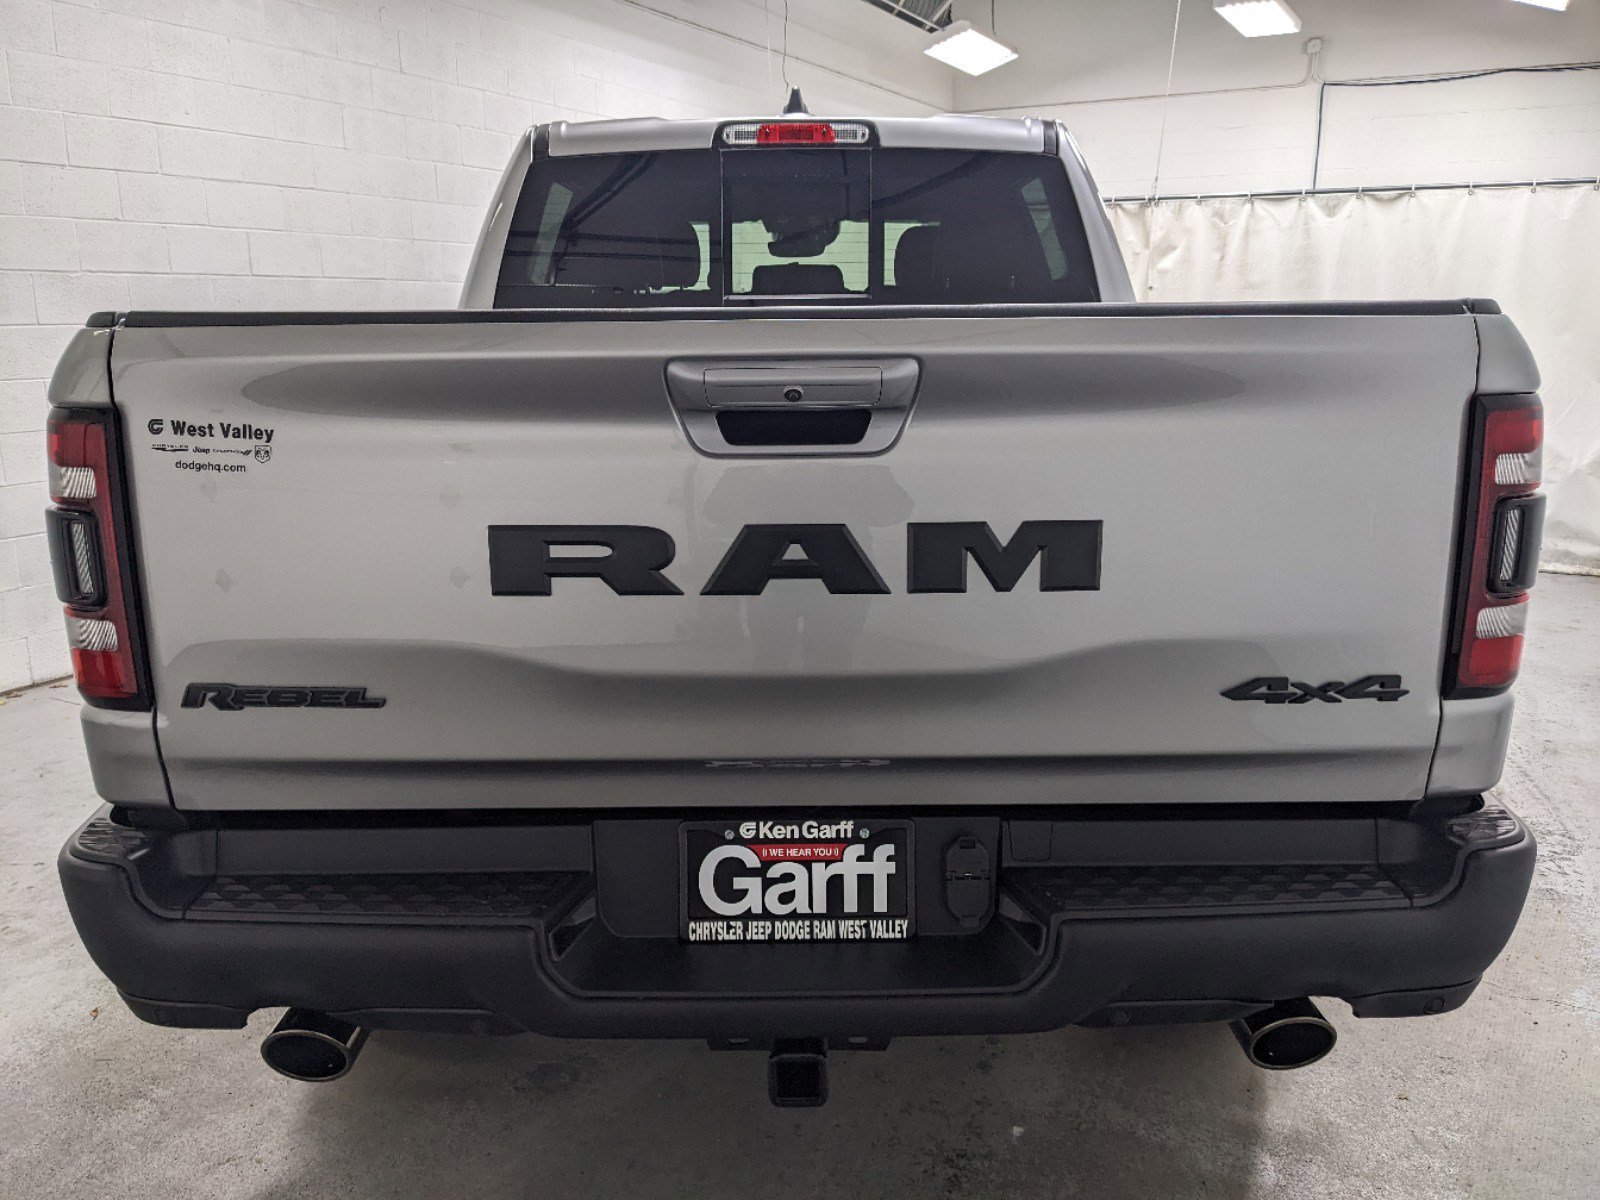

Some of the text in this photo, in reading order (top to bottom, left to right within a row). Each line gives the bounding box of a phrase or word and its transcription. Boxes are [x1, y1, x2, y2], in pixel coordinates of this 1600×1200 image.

[170, 420, 215, 438] West
[219, 422, 275, 443] Valley
[175, 460, 247, 473] dodgehq.com
[487, 519, 1104, 596] RAM
[181, 682, 387, 711] REBEL
[759, 821, 799, 839] Ken
[801, 820, 854, 839] Garff
[769, 847, 832, 857] WE HEAR YOU
[698, 843, 896, 917] Garff
[688, 919, 909, 942] CHRYSLER JEEP DODGE RAM WEST VALLEY
